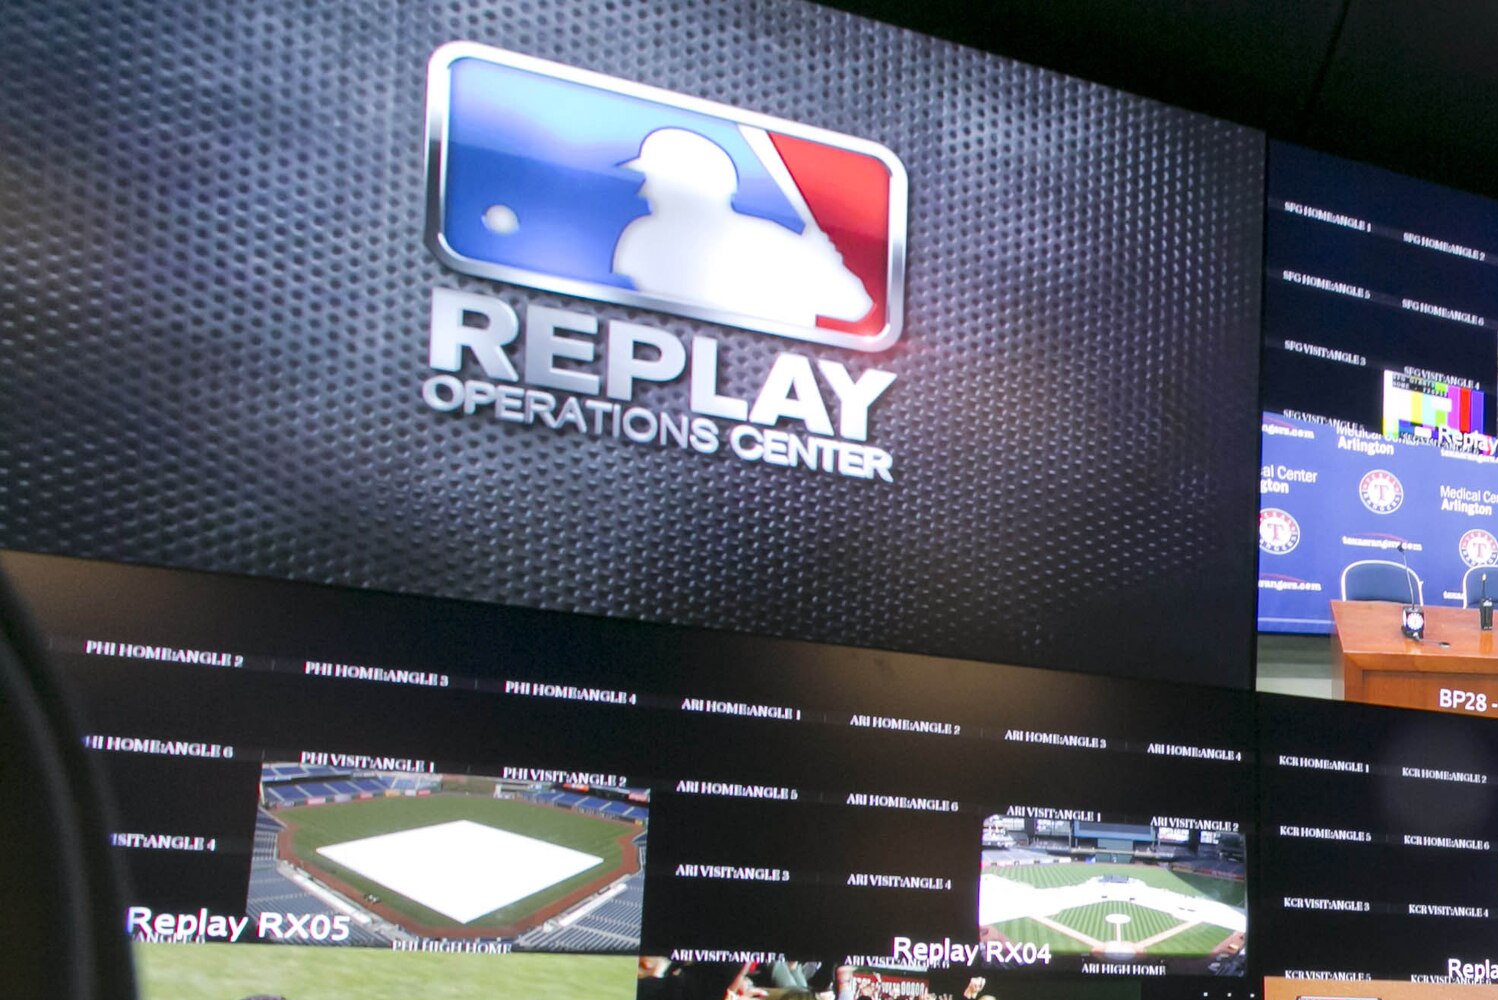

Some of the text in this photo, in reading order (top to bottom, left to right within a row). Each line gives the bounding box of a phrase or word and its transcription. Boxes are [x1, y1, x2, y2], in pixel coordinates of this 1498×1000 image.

[429, 287, 898, 441] REPLAY
[422, 375, 894, 483] OPERATIONS CENTER
[1337, 436, 1394, 456] Arlington
[1438, 427, 1498, 456] Replay
[1277, 466, 1318, 483] Center
[1440, 485, 1480, 502] Medical
[1441, 498, 1492, 516] Arlington
[85, 639, 116, 656] PHI
[234, 655, 244, 668] 2
[305, 660, 333, 677] PHI
[439, 675, 449, 687] 3
[505, 680, 531, 695] PHI
[628, 693, 637, 705] 4
[1439, 688, 1488, 712] BP28
[681, 698, 704, 712] ARI
[796, 709, 801, 721] 1
[850, 714, 871, 727] ARI
[953, 724, 961, 736] 2
[1004, 729, 1024, 742] ARI
[1099, 738, 1107, 749] 3
[1147, 742, 1165, 755] ARI
[1235, 751, 1242, 762] 4
[676, 780, 700, 794] ARI
[790, 789, 799, 800] 5
[846, 793, 868, 806] ARI
[950, 801, 959, 812] 6
[112, 833, 205, 851] ISIT:ANGLE
[675, 863, 699, 877] ARI
[781, 870, 790, 882] 3
[847, 873, 869, 886] ARI
[944, 879, 952, 890] 4
[128, 907, 350, 943] Replay RX05
[894, 937, 1051, 967] Replay RX04
